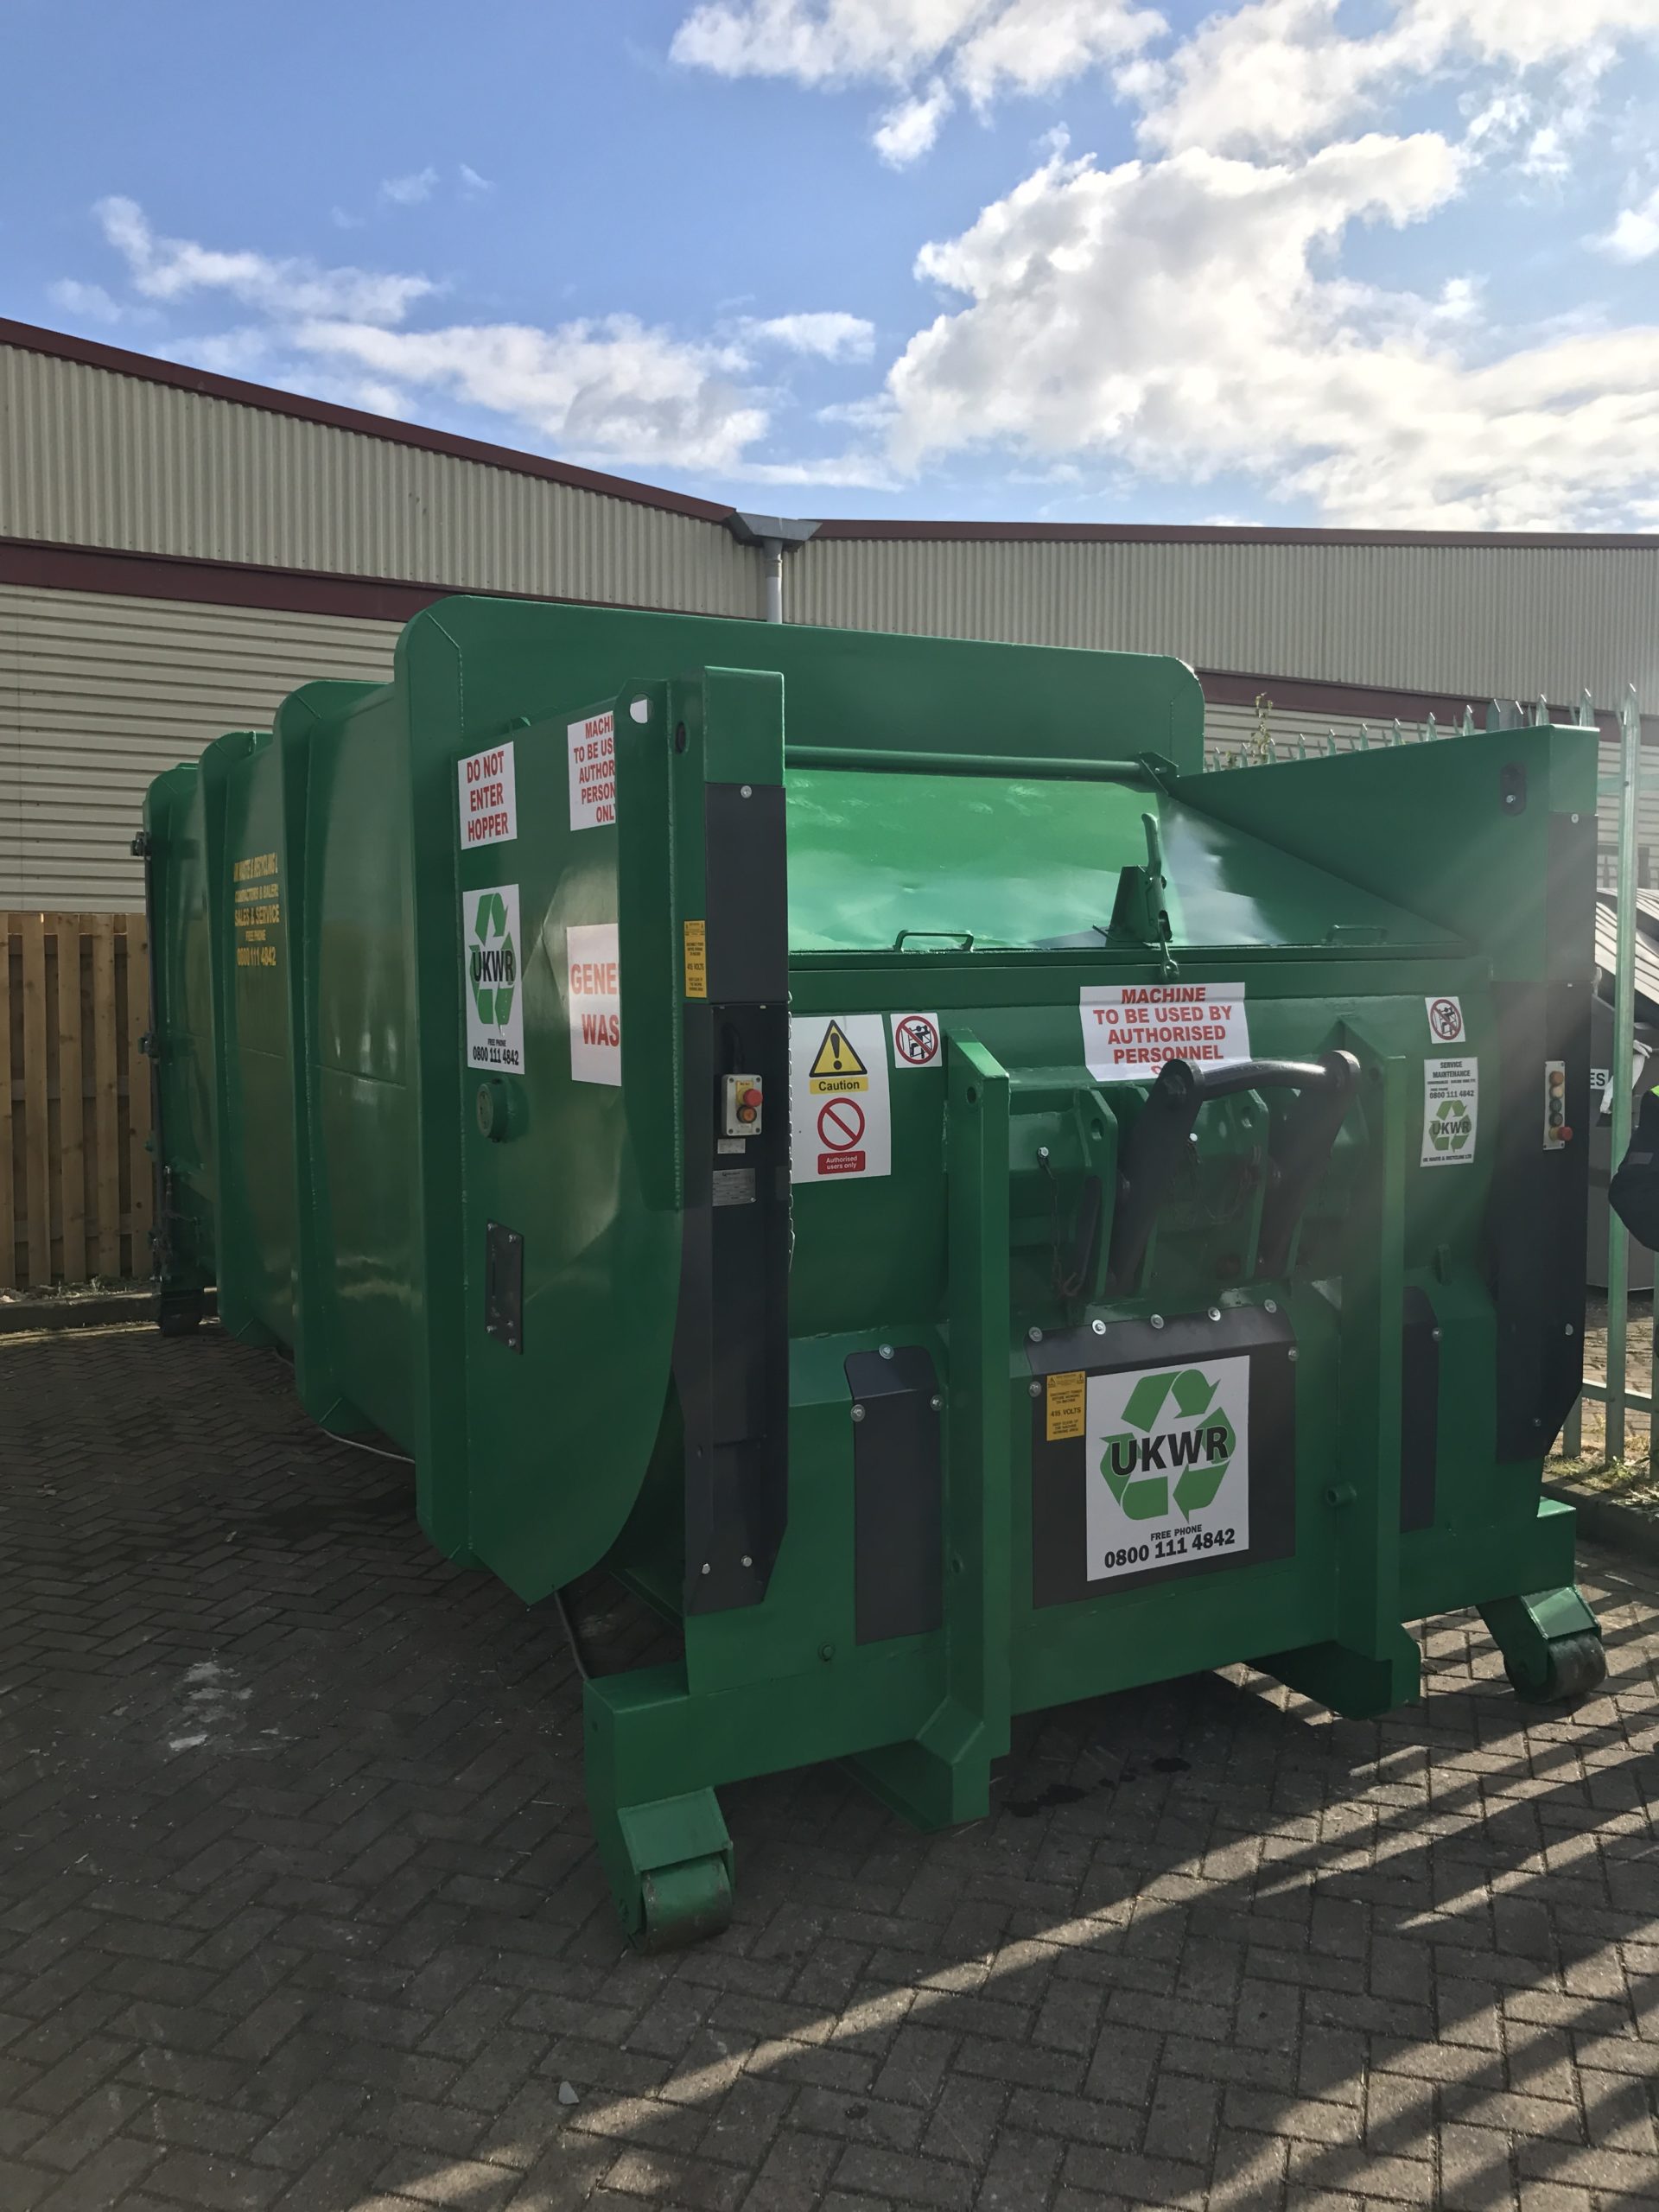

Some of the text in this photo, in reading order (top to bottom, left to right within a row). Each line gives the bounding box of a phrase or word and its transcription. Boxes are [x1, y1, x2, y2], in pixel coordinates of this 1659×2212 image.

[574, 737, 614, 763] TO BE US
[467, 751, 504, 784] DO NOT
[579, 760, 615, 784] AUTHOR
[470, 782, 504, 811] ENTER
[596, 804, 616, 823] ONL
[468, 812, 509, 842] HOPPER
[472, 950, 515, 982] UKWR
[570, 963, 618, 995] GENE
[1122, 987, 1206, 1004] MACHINE
[1093, 1005, 1231, 1025] TO BE USED BY
[582, 1014, 620, 1047] WAS
[1108, 1025, 1226, 1045] AUTHORISED
[473, 1046, 518, 1066] 0800 111 4842
[1113, 1045, 1224, 1065] PERSONNEL
[1433, 1070, 1471, 1078] MAINTENANCE
[818, 1080, 860, 1091] Caution
[1432, 1121, 1471, 1135] UKWR
[826, 1155, 858, 1164] Authorised
[1063, 1407, 1081, 1415] VOLTS
[1110, 1426, 1229, 1476] UKWR
[1150, 1524, 1203, 1541] FREE PHONE
[1104, 1528, 1235, 1568] 0800 111 4842
